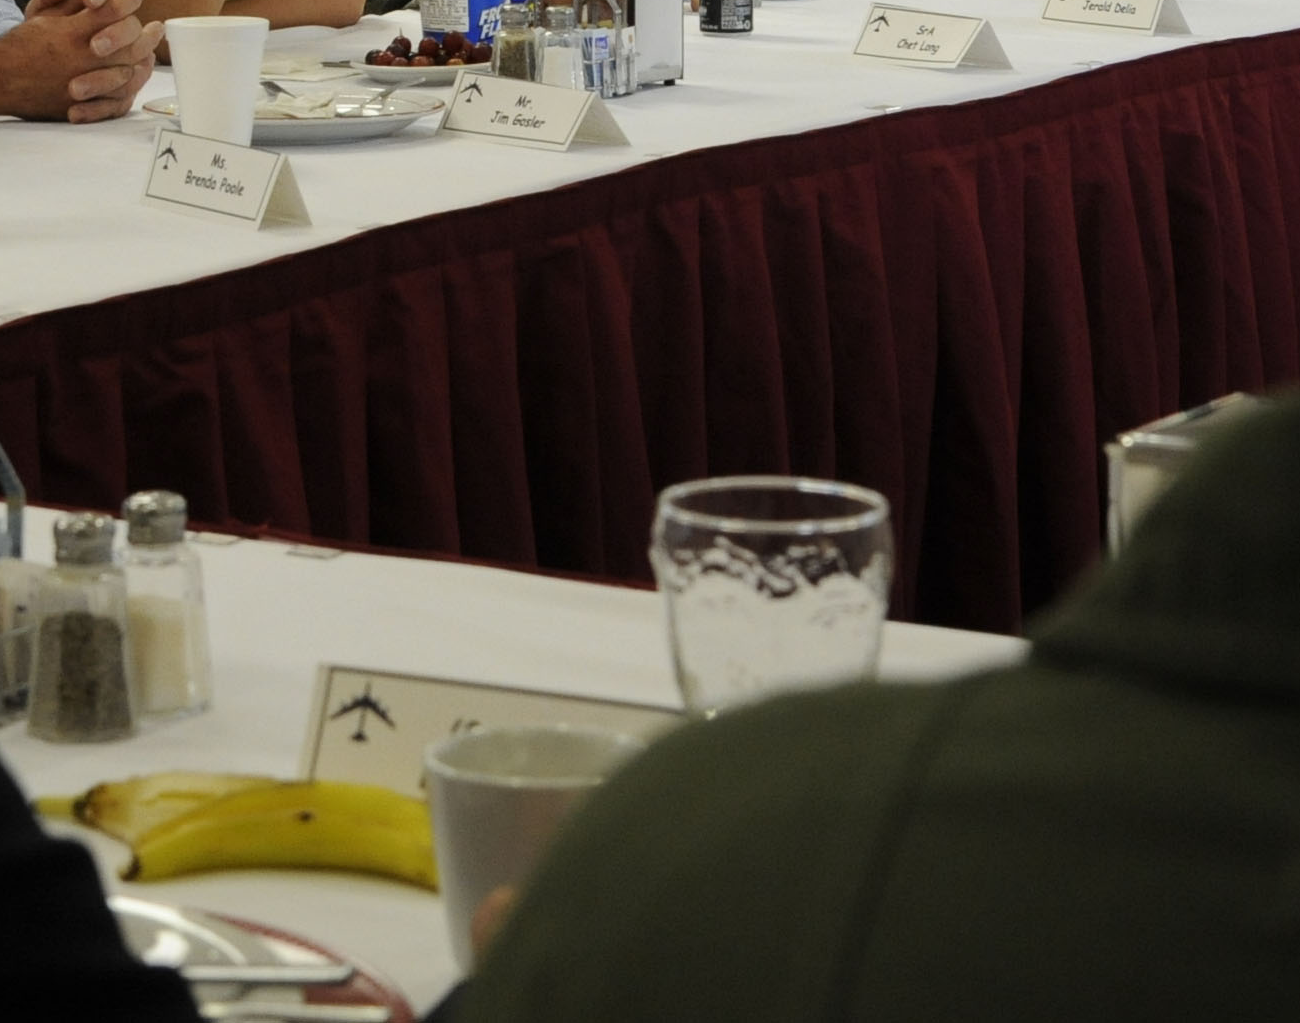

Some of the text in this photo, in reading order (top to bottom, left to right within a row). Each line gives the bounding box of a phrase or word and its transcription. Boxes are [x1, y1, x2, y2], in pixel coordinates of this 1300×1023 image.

[1082, 0, 1137, 15] Jerald Delia
[916, 24, 936, 36] SrA
[514, 95, 533, 110] Mr.
[490, 110, 510, 126] Jim
[210, 152, 228, 171] Ms.
[184, 169, 246, 197] Brenda Poole
